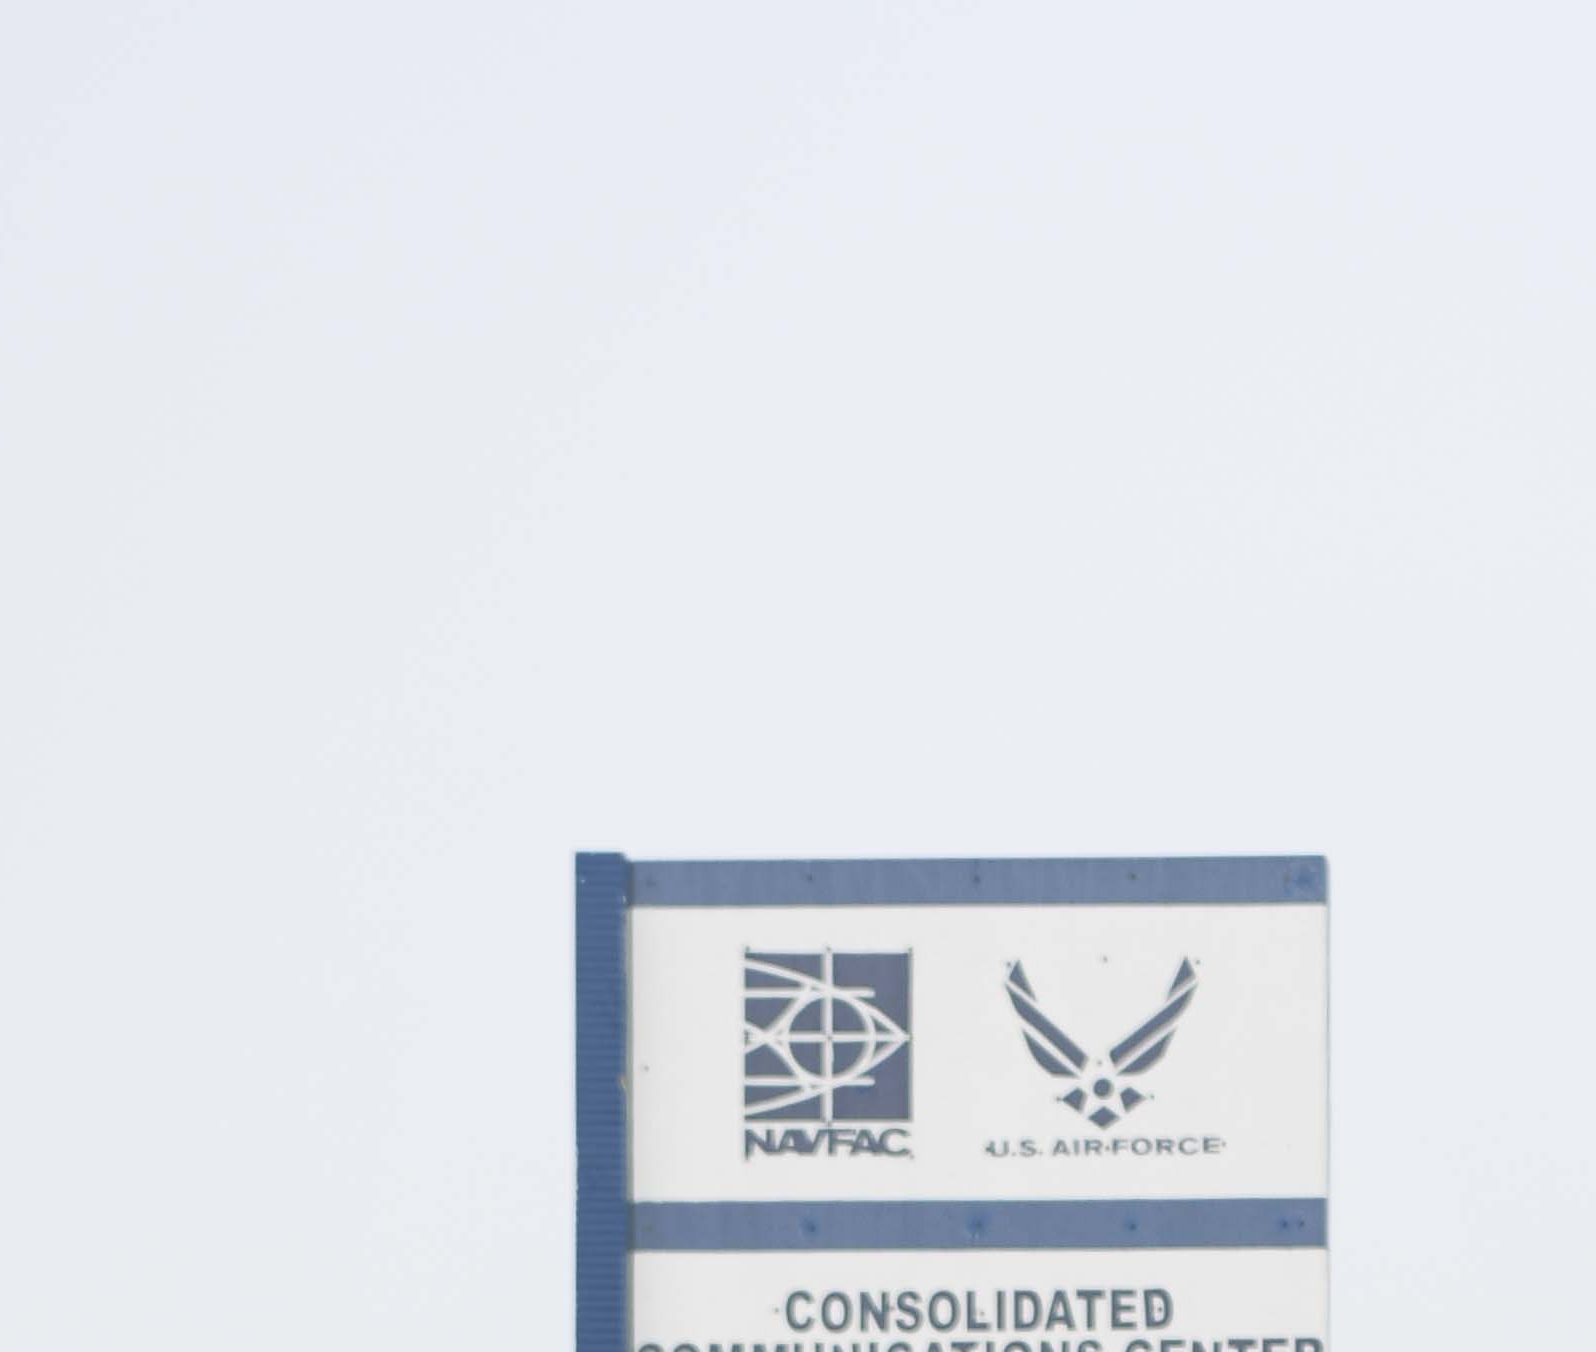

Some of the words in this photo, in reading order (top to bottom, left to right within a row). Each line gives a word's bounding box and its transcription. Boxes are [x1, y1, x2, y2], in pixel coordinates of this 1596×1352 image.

[745, 1128, 912, 1158] NAVFAC
[1052, 1138, 1104, 1157] AIR
[1110, 1136, 1223, 1156] FORCE
[785, 1288, 1174, 1332] CONSOLIDATED
